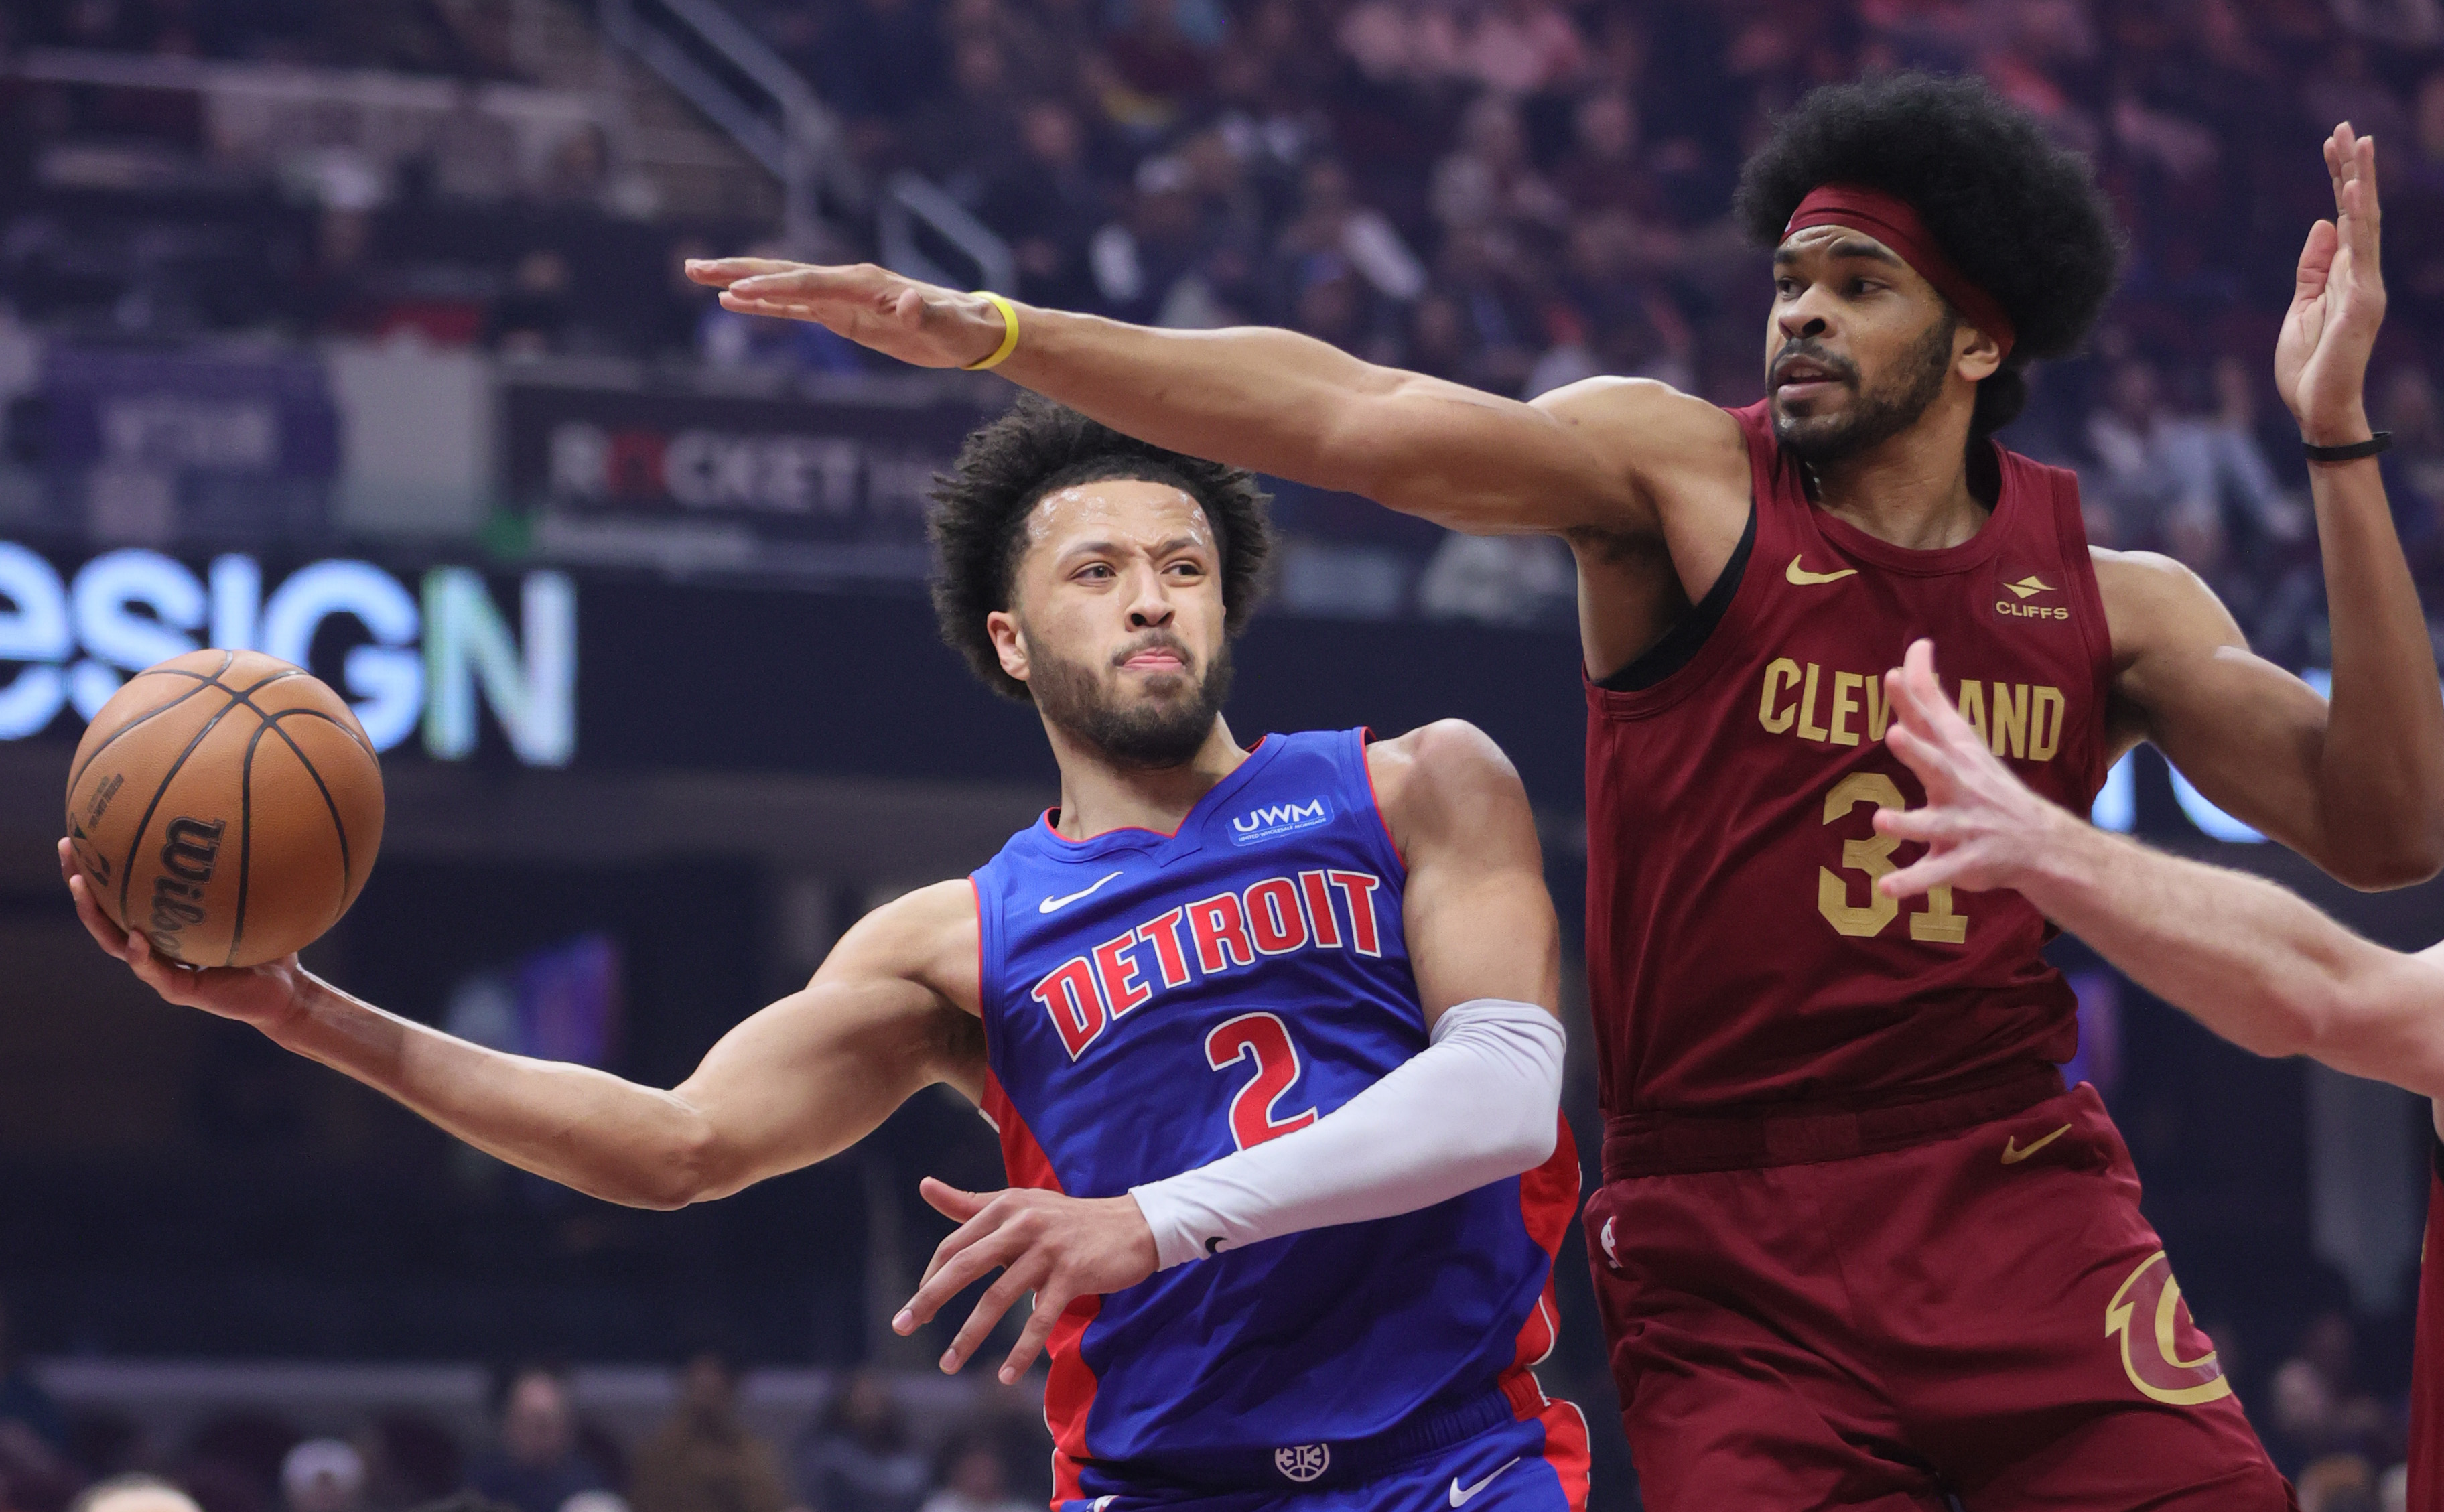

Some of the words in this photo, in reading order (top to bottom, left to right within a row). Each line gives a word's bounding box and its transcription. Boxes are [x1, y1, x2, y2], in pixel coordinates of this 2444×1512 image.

[1995, 600, 2069, 620] CLIFFS
[1757, 657, 2065, 762] CLEVAND
[1233, 799, 1325, 832] UWM
[1238, 833, 1260, 843] UNITED
[1260, 825, 1293, 837] WHOLESALE
[1294, 817, 1326, 829] MORTGAGE
[151, 816, 226, 959] Wilso
[1030, 869, 1382, 1062] DETROIT
[1205, 1011, 1319, 1152] 2
